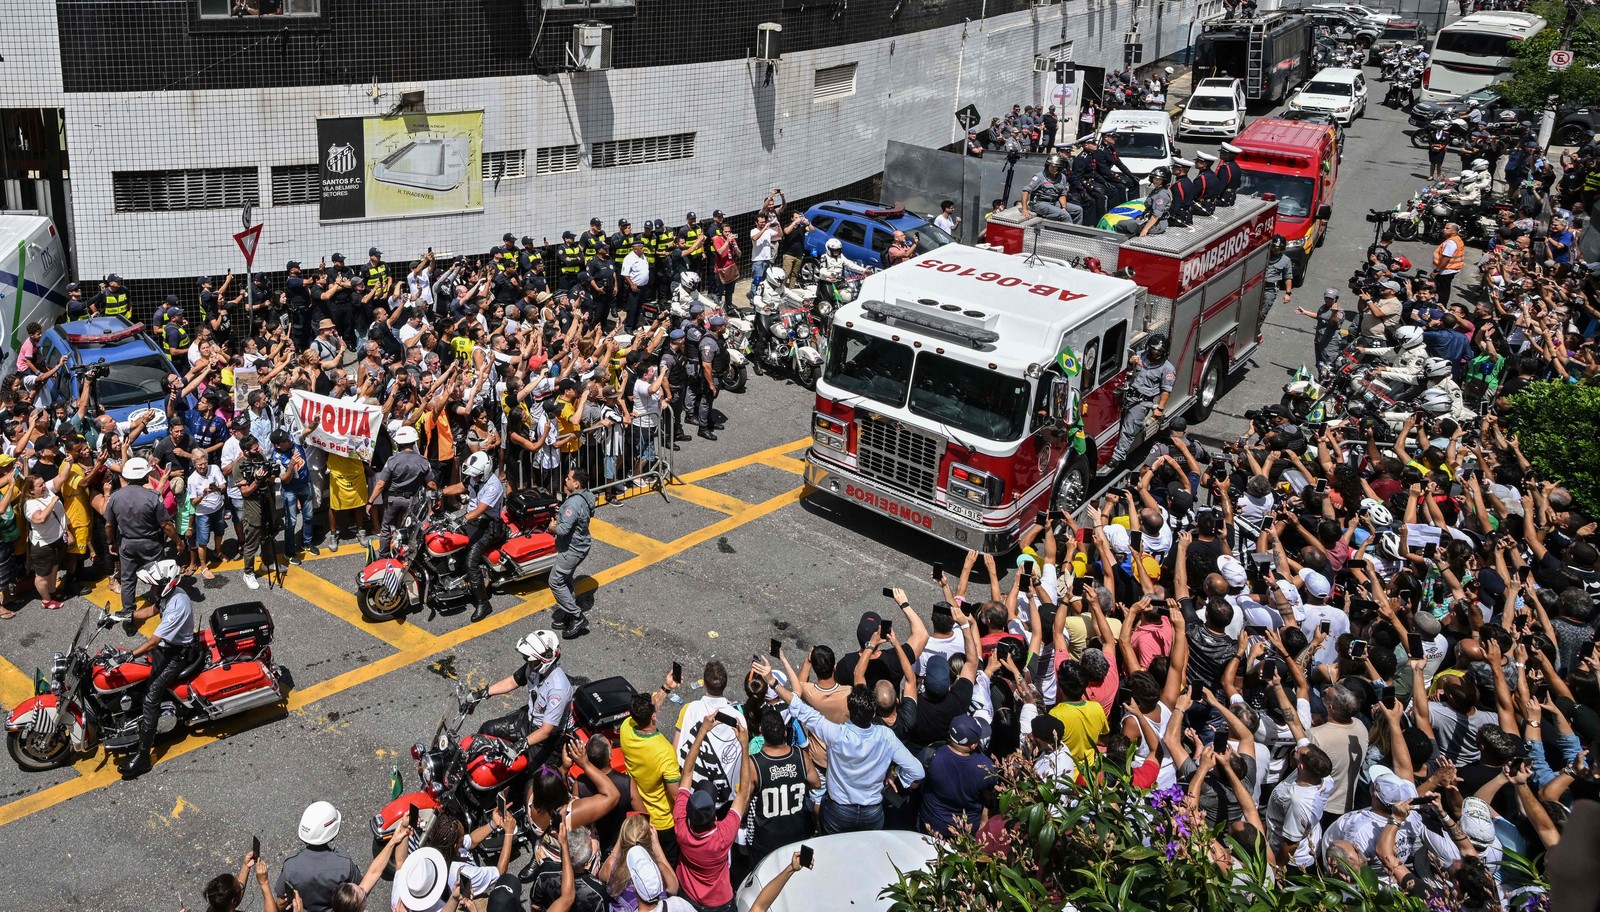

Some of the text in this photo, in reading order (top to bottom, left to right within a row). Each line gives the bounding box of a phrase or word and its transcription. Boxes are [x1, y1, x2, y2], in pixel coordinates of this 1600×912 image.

[1182, 227, 1251, 287] BOMBEIROS
[915, 259, 1089, 302] AB-06105
[761, 782, 806, 819] 013
